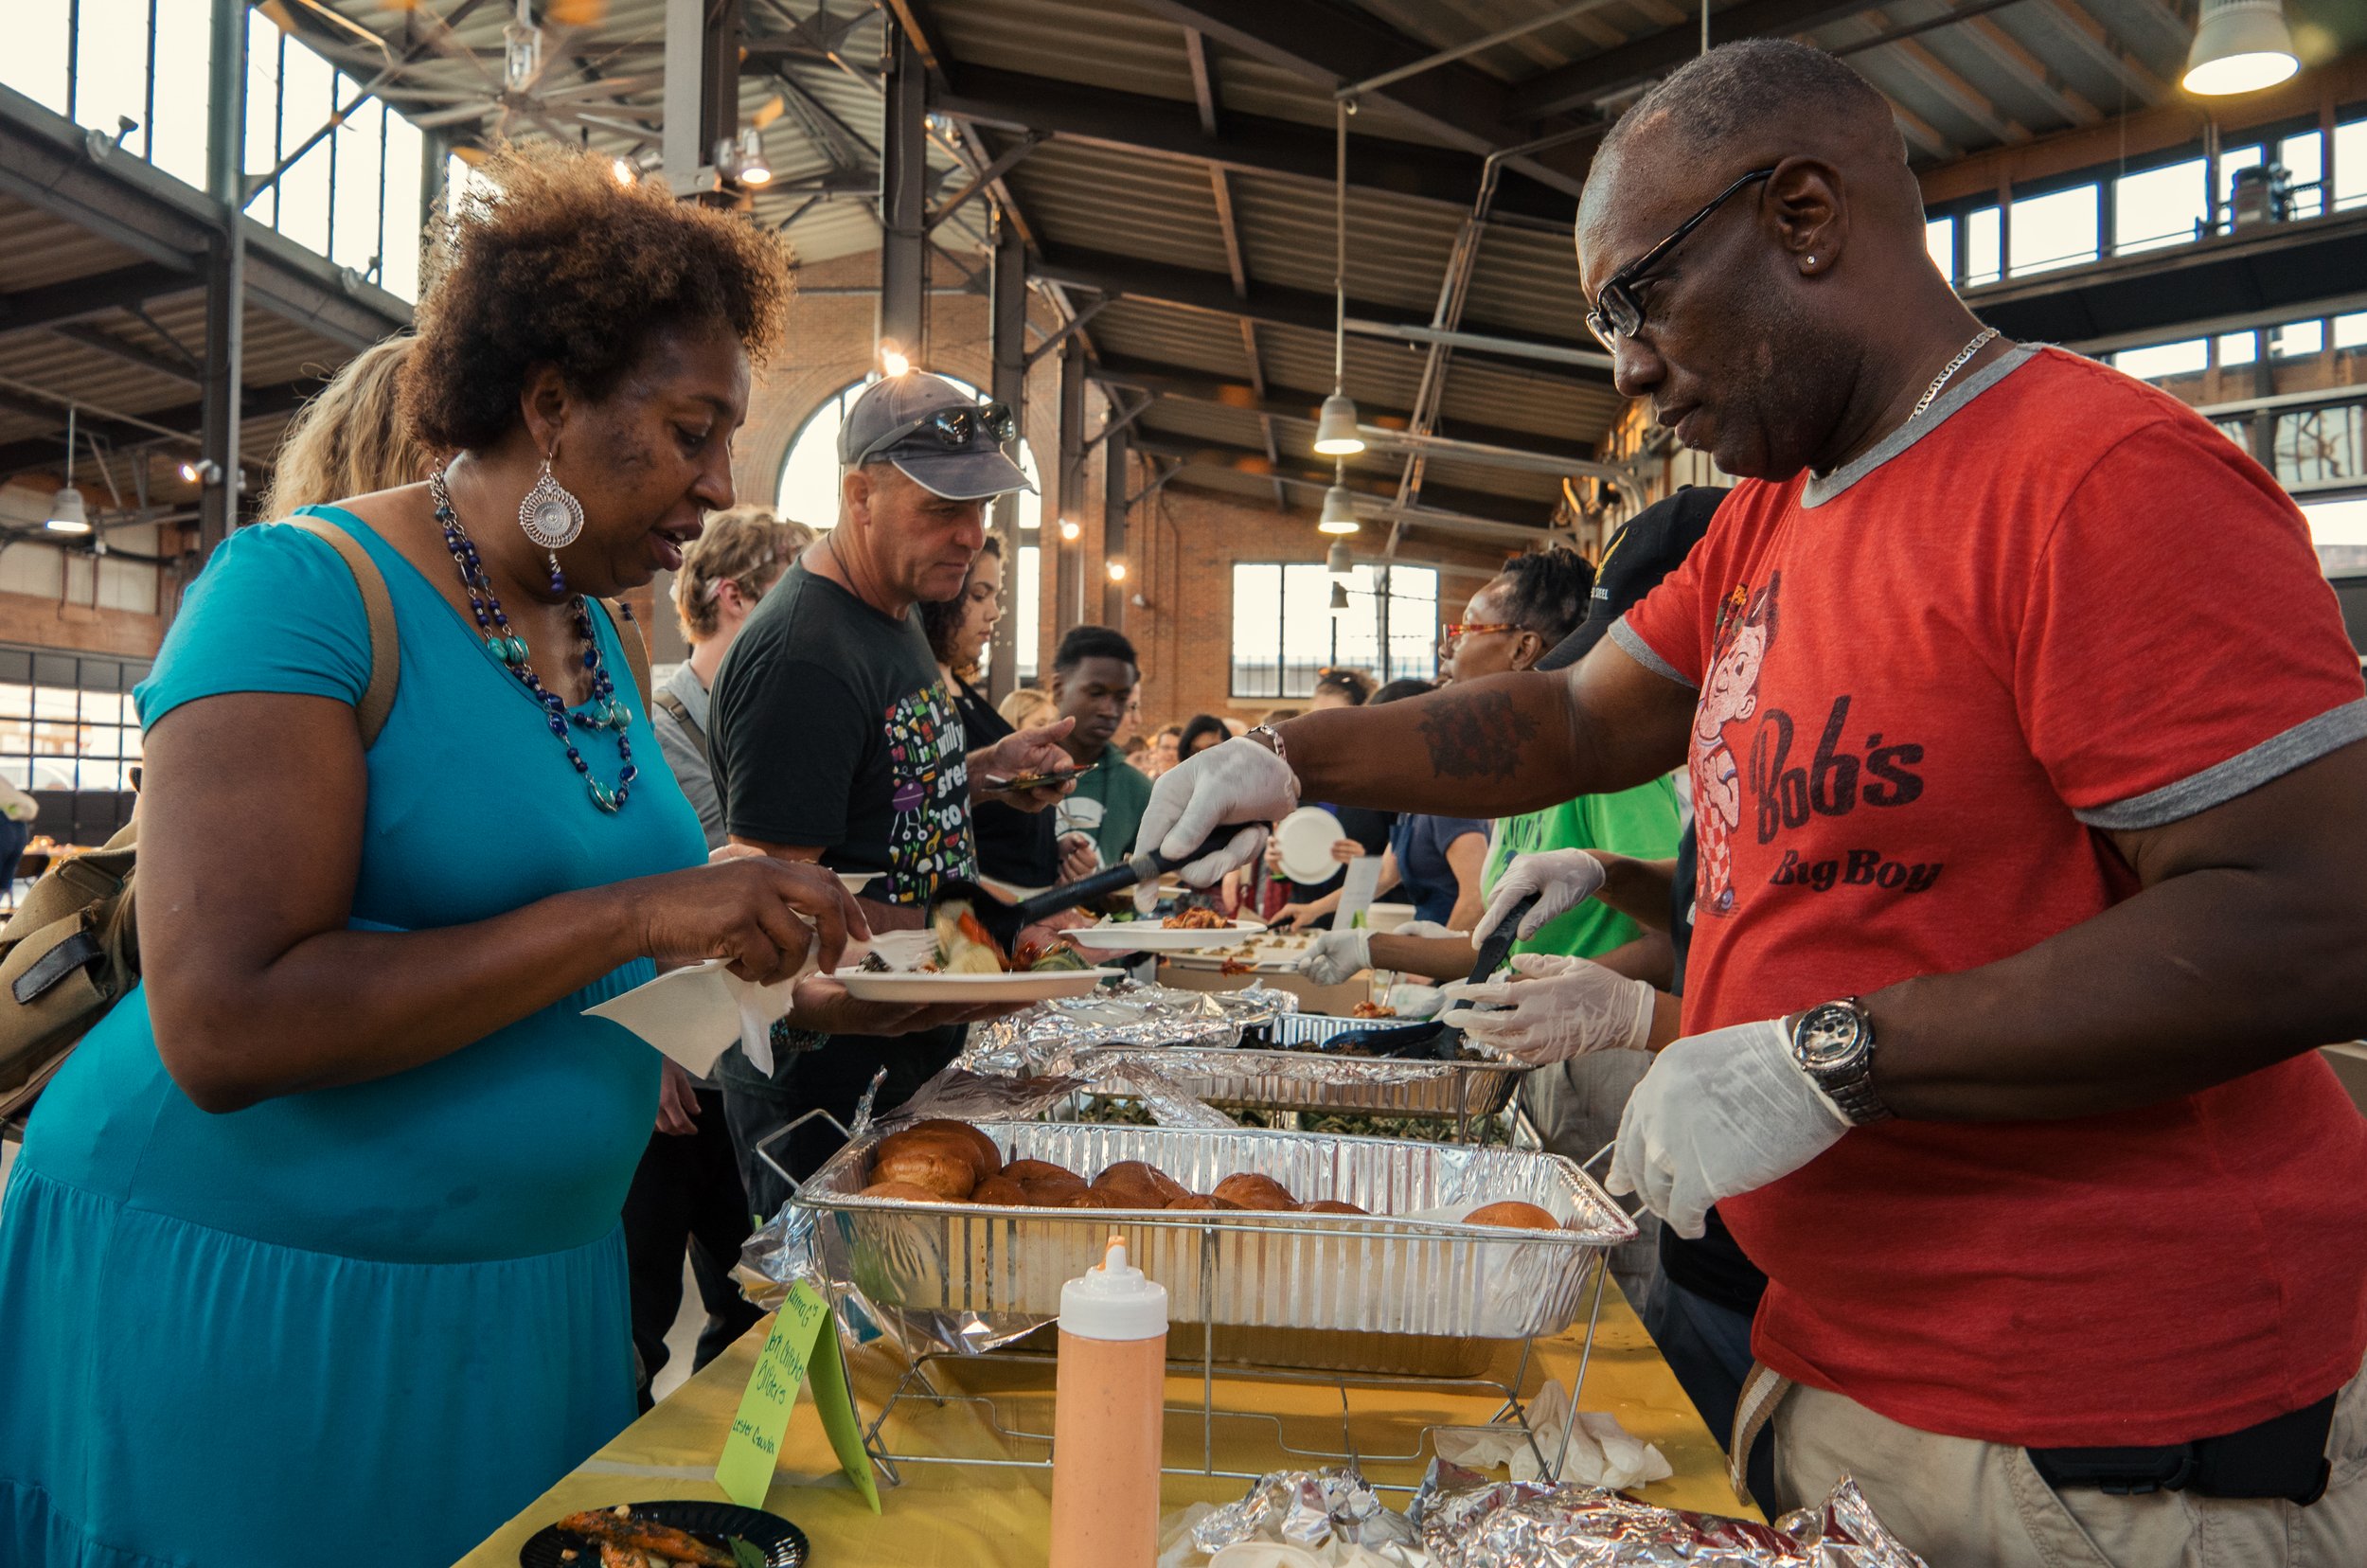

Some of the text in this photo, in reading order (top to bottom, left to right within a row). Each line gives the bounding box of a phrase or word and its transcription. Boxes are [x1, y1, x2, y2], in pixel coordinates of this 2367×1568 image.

[936, 721, 964, 758] willy
[1748, 695, 1924, 845] Bob's
[1770, 849, 1944, 894] Big Boy
